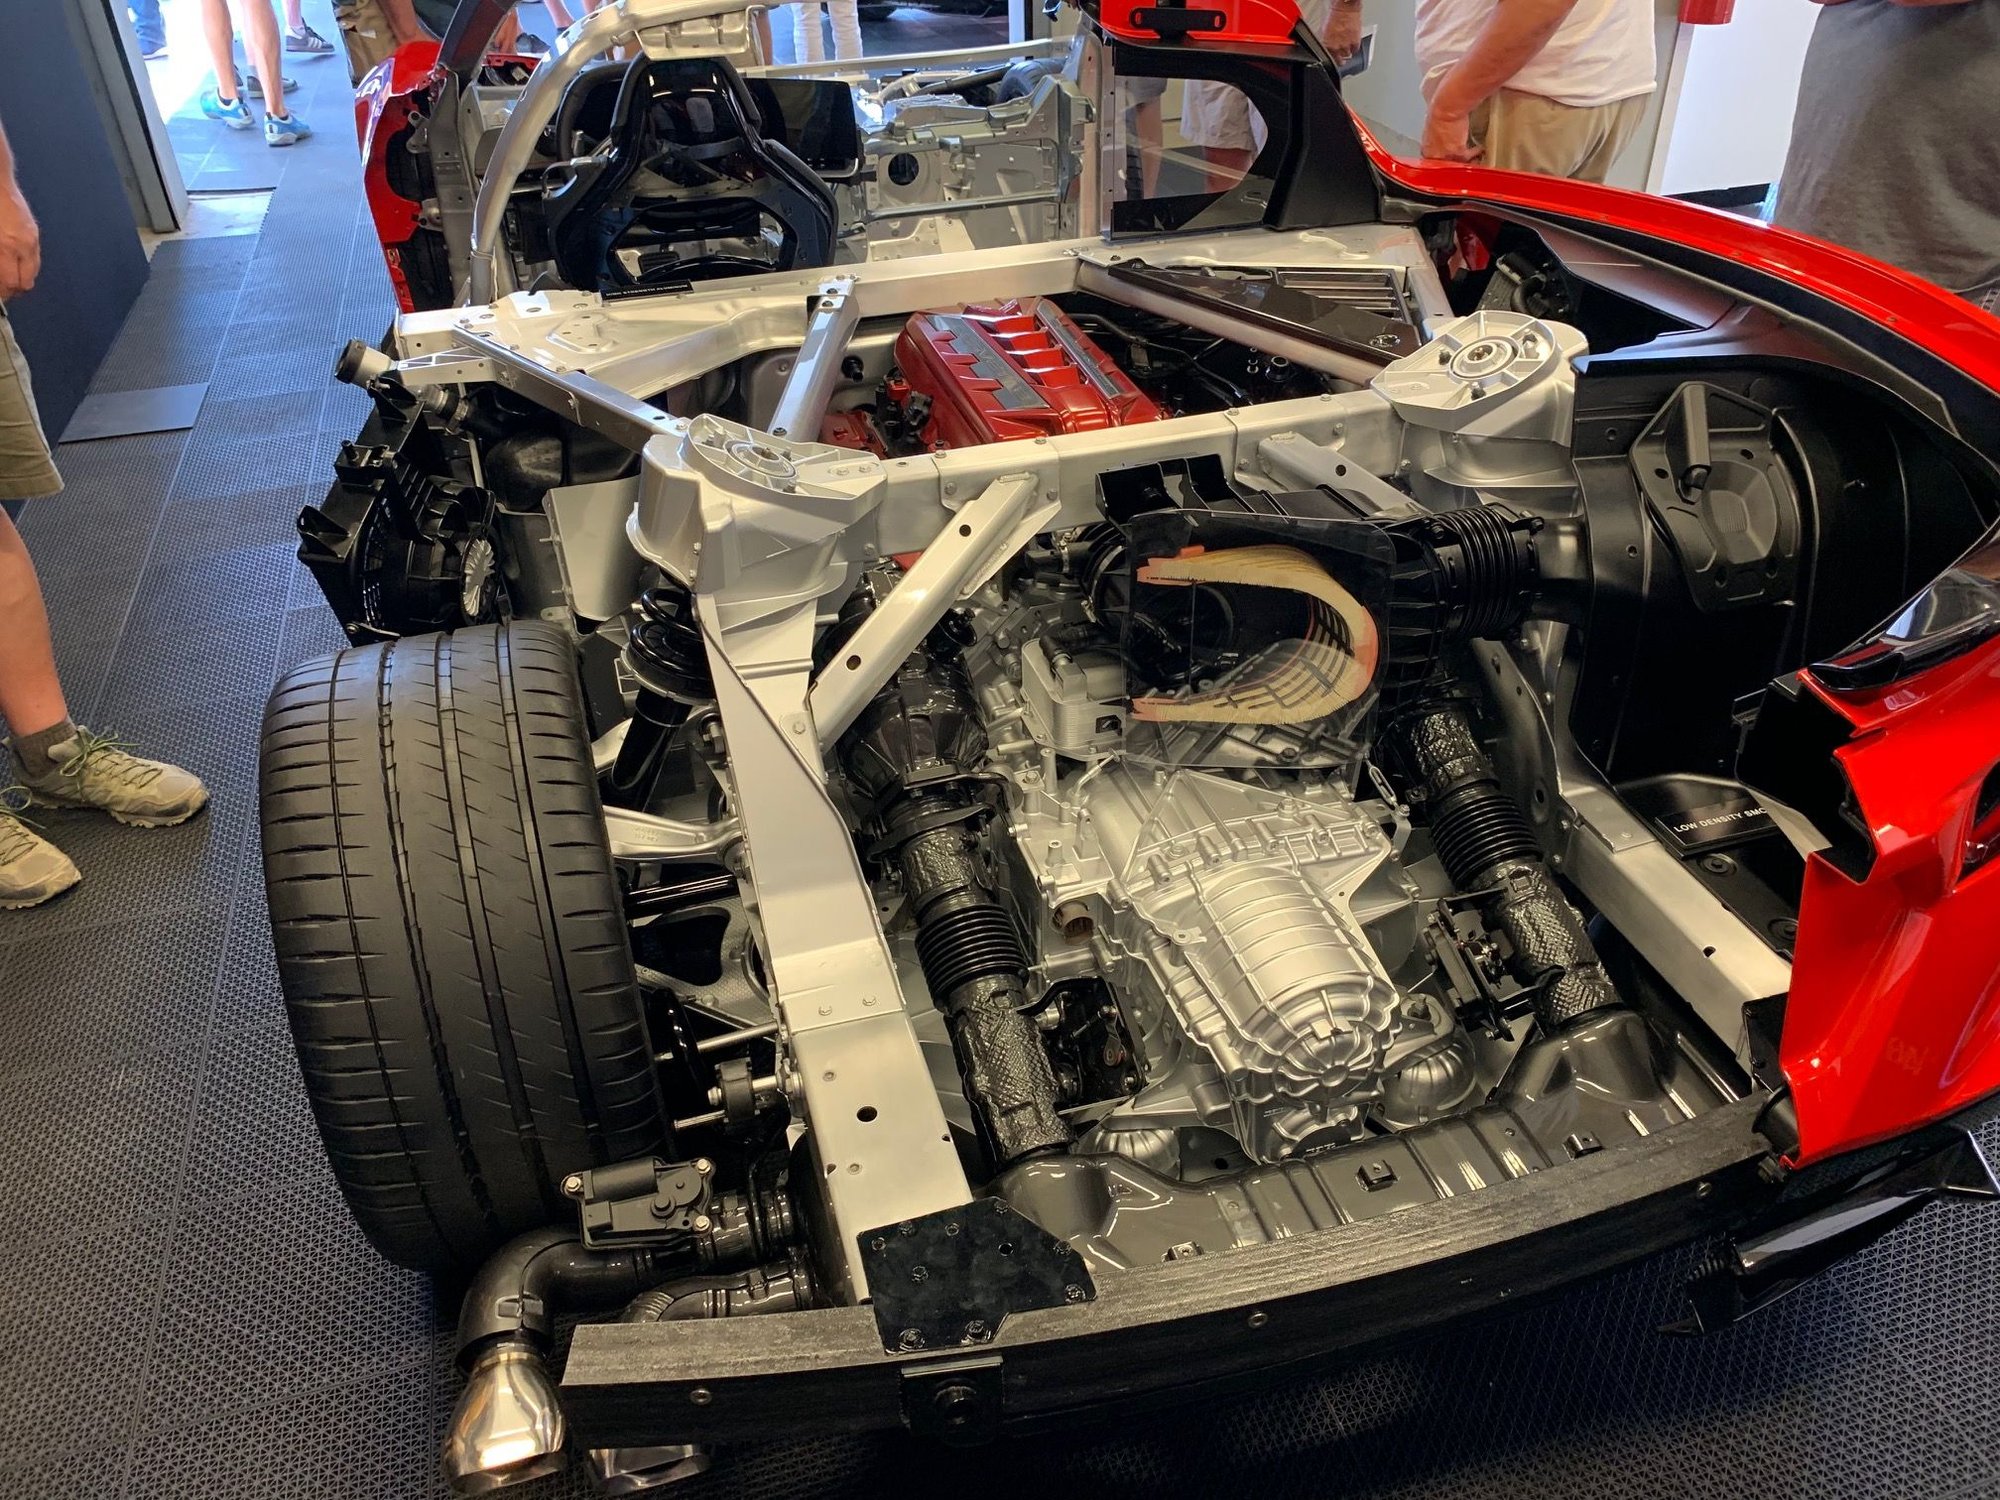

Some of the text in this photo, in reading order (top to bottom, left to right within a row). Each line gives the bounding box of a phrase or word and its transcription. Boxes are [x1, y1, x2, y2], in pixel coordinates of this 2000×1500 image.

[1673, 807, 1768, 832] LOW DENSITY SMC
